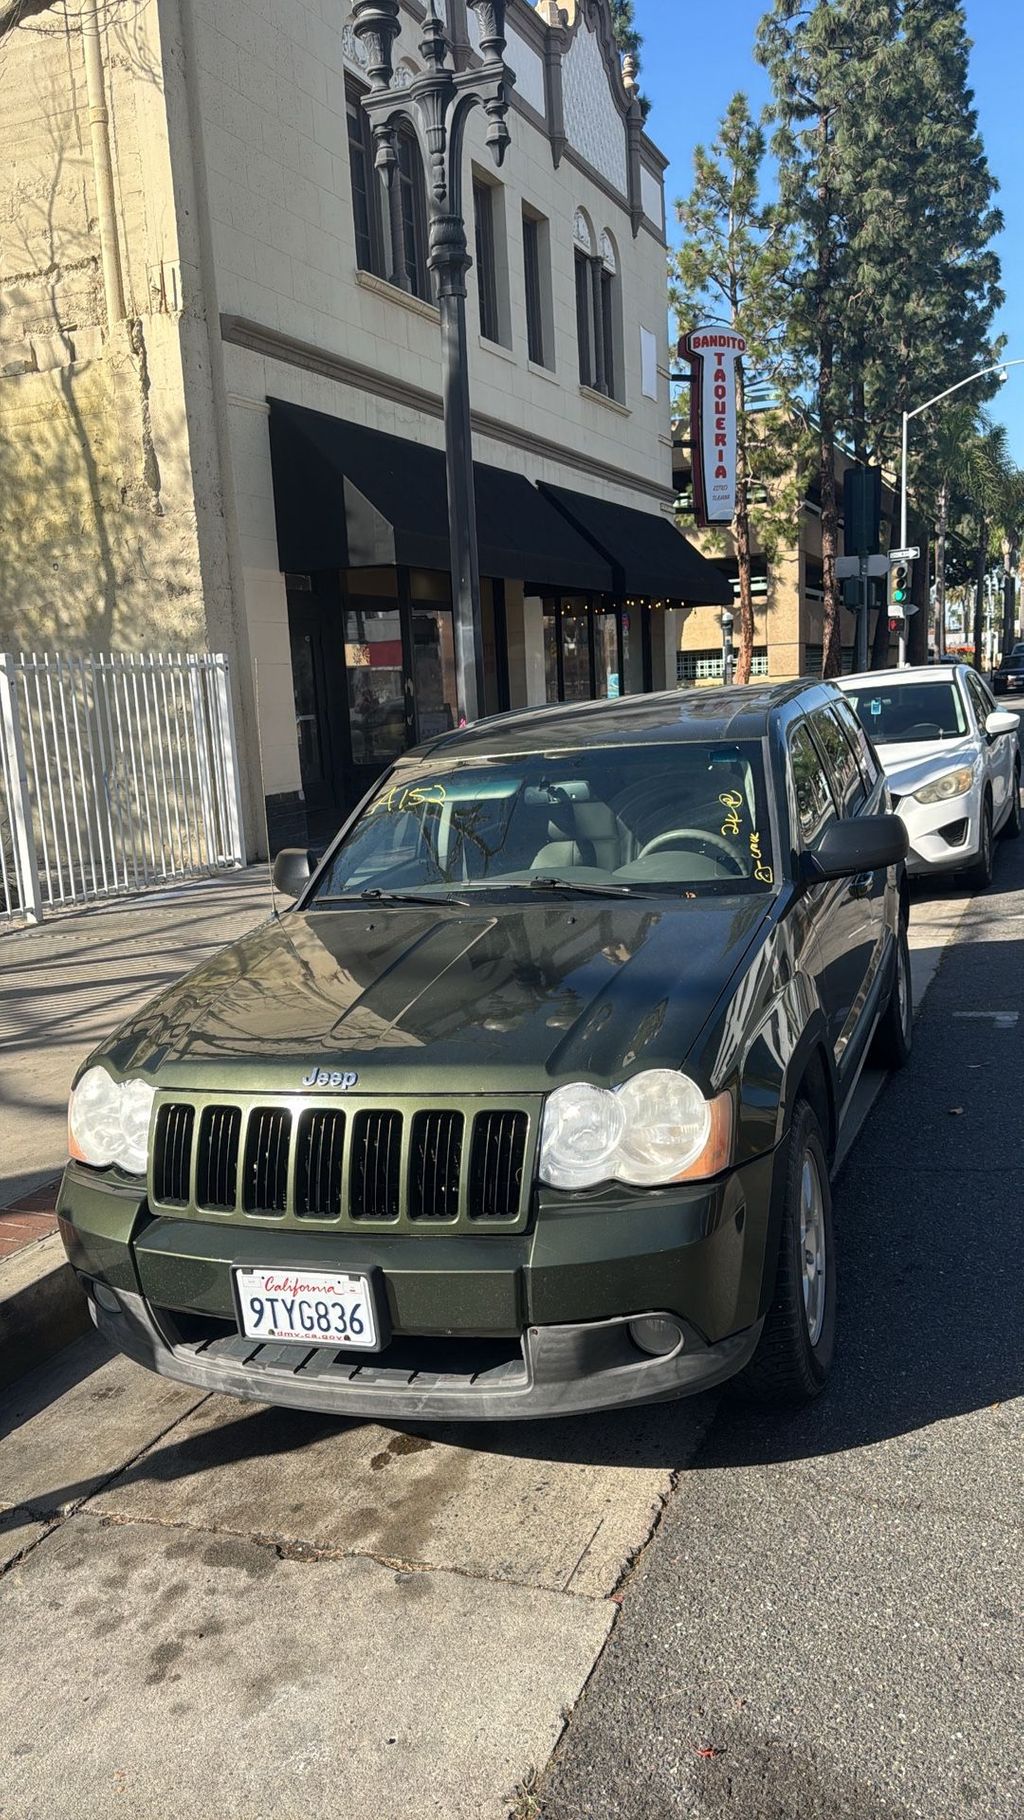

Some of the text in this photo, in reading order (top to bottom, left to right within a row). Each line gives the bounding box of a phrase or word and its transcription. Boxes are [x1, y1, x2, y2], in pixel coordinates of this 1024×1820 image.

[692, 335, 746, 352] BANDITO
[713, 352, 727, 479] TAQUERIA
[302, 1066, 358, 1090] Jeep
[265, 1275, 345, 1297] California
[250, 1297, 364, 1335] 9TYG836
[275, 1331, 344, 1341] dmv.ca.gov
